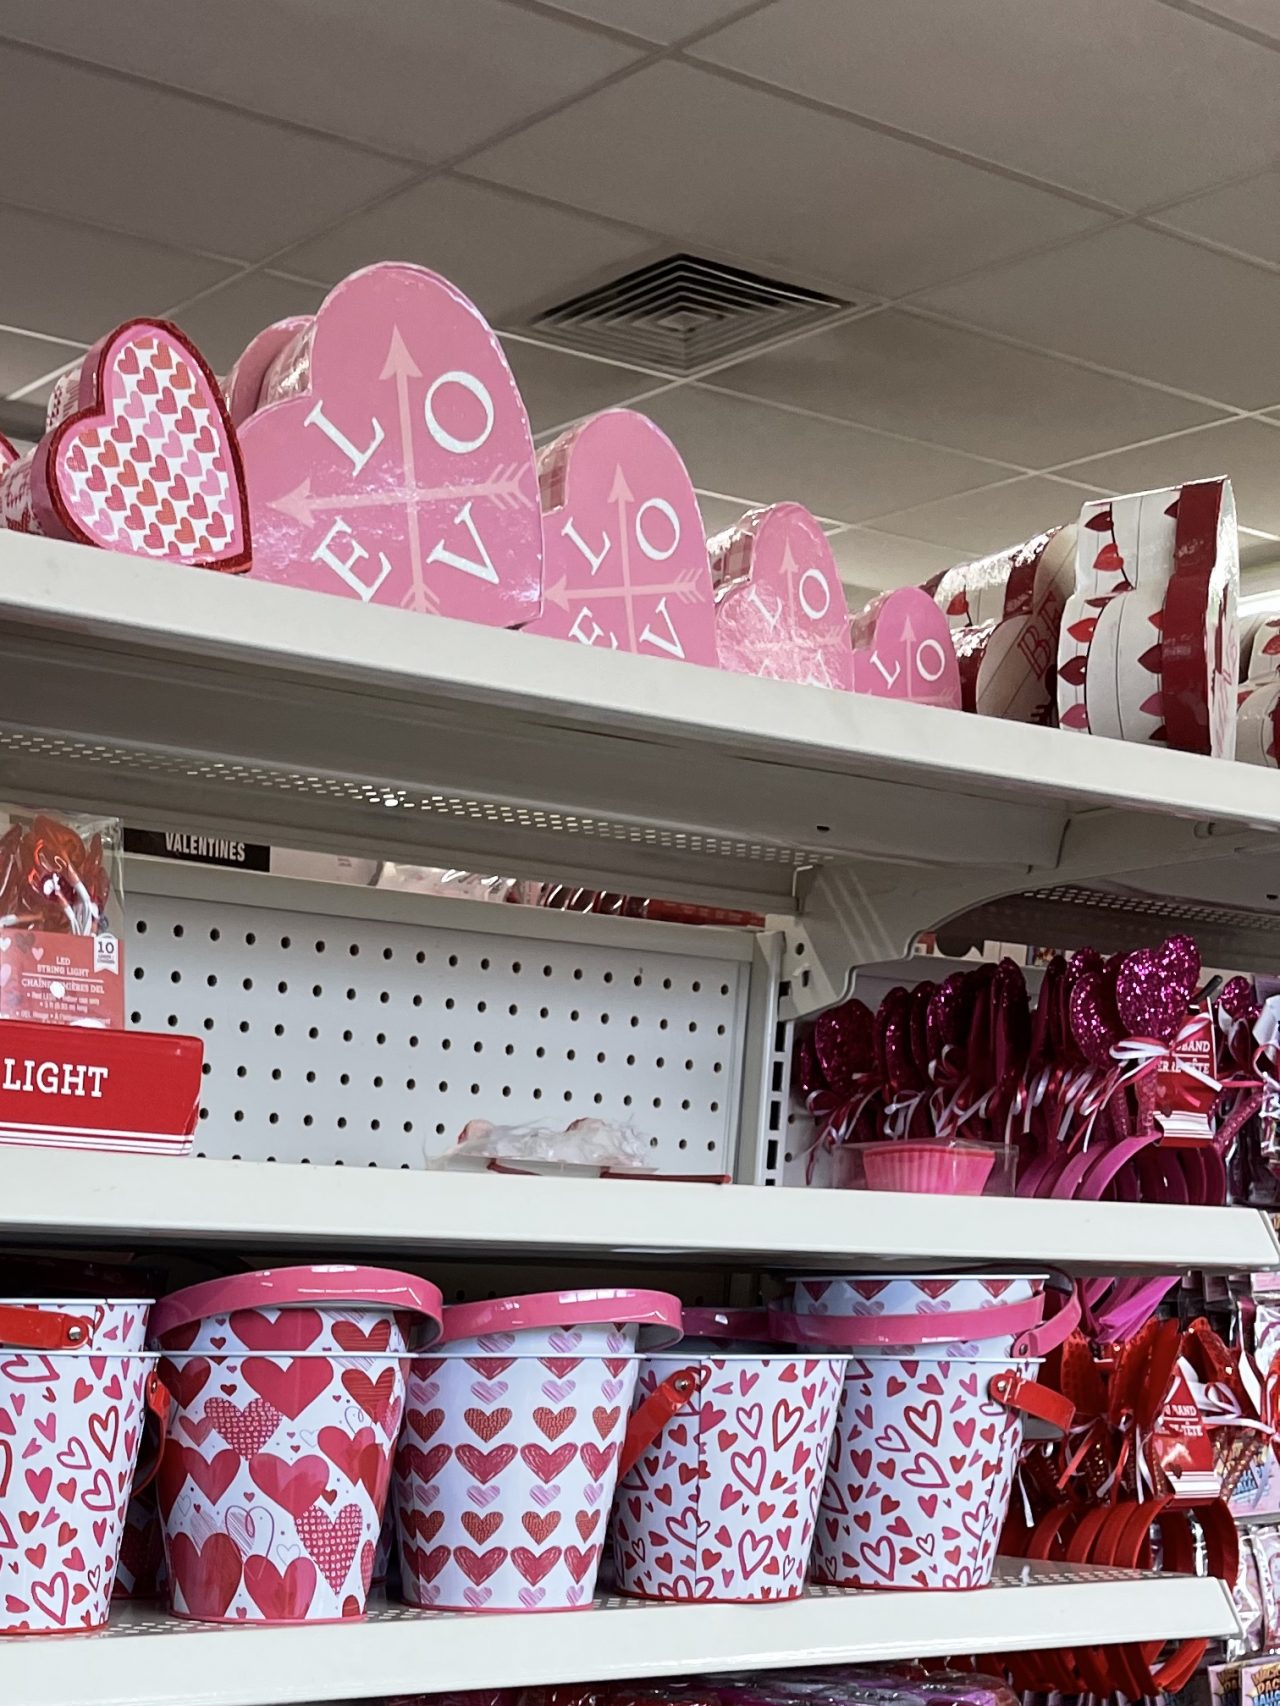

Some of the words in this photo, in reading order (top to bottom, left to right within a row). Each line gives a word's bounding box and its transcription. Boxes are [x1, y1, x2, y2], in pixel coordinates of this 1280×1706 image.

[165, 832, 245, 862] VALENTINES
[97, 941, 115, 954] 10
[2, 1059, 109, 1099] LIGHT
